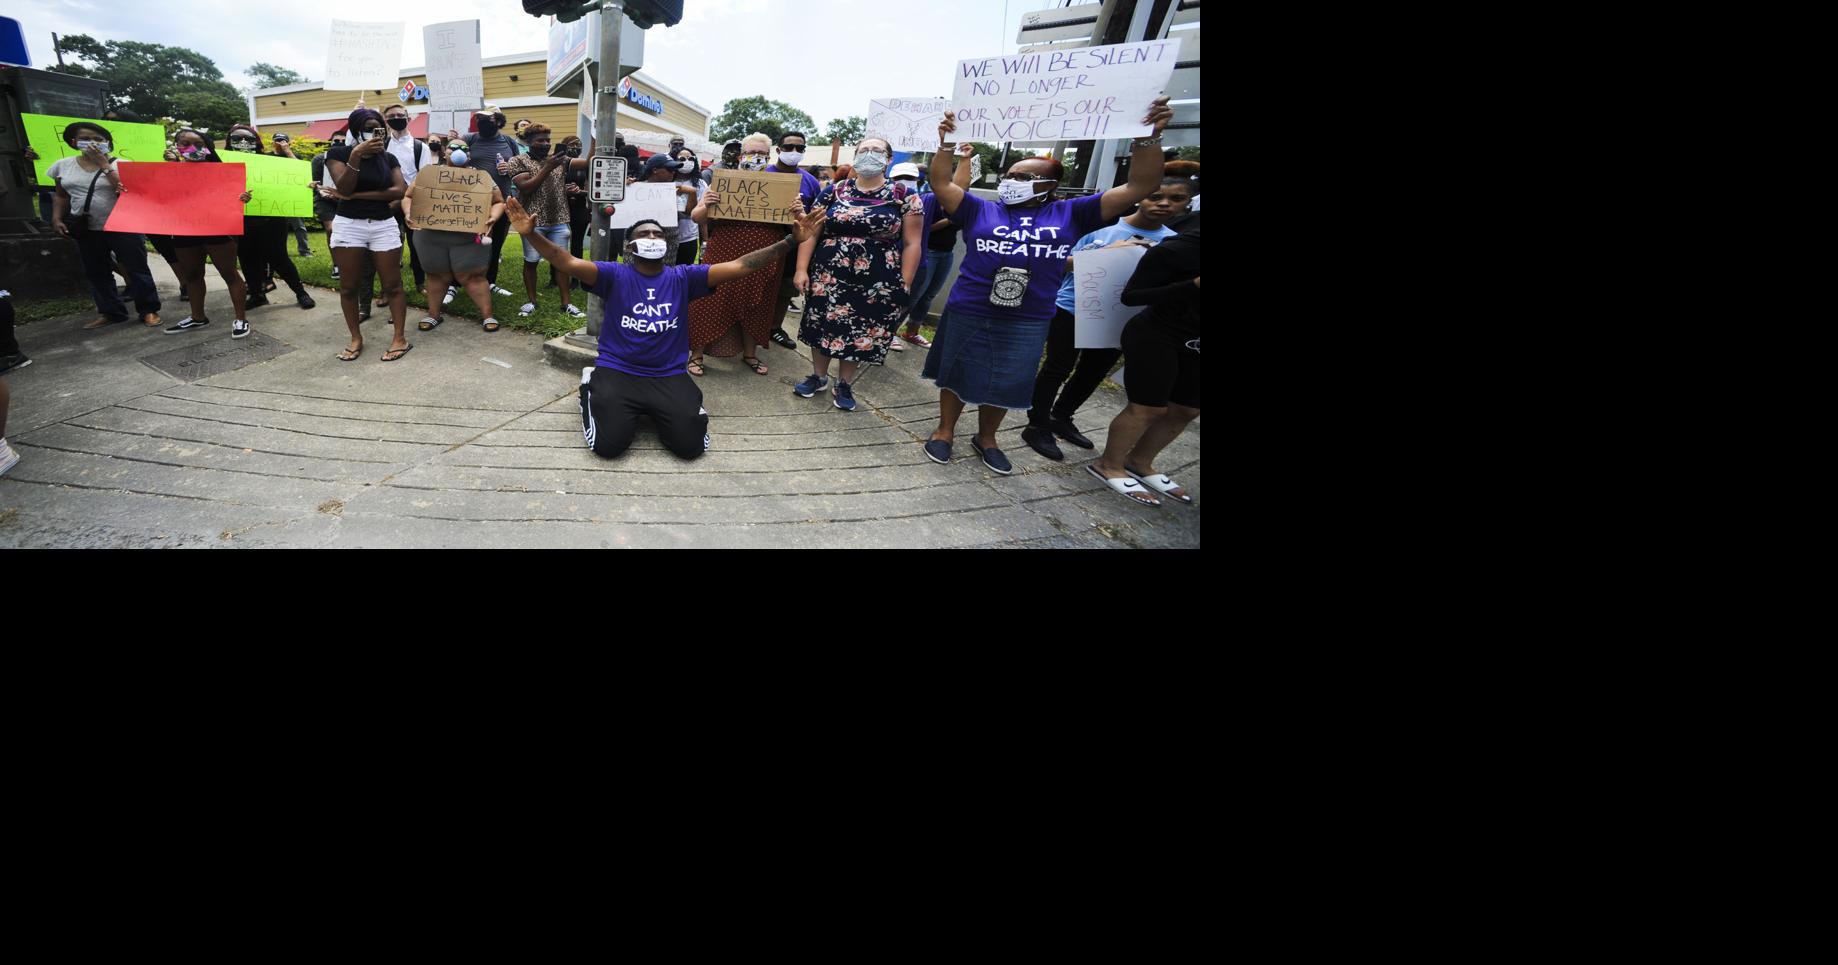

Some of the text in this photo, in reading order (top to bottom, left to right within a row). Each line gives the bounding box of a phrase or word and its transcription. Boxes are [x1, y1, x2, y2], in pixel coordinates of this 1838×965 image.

[963, 59, 997, 78] WE
[1048, 51, 1086, 74] BE
[973, 79, 1000, 97] NO
[957, 107, 991, 122] OUR
[1047, 101, 1068, 118] IS
[717, 178, 769, 197] BLACK
[433, 204, 483, 214] MATTER
[718, 194, 770, 207] LIVES
[1020, 217, 1033, 227] I
[976, 238, 1070, 259] BREATHE
[646, 288, 656, 301] I
